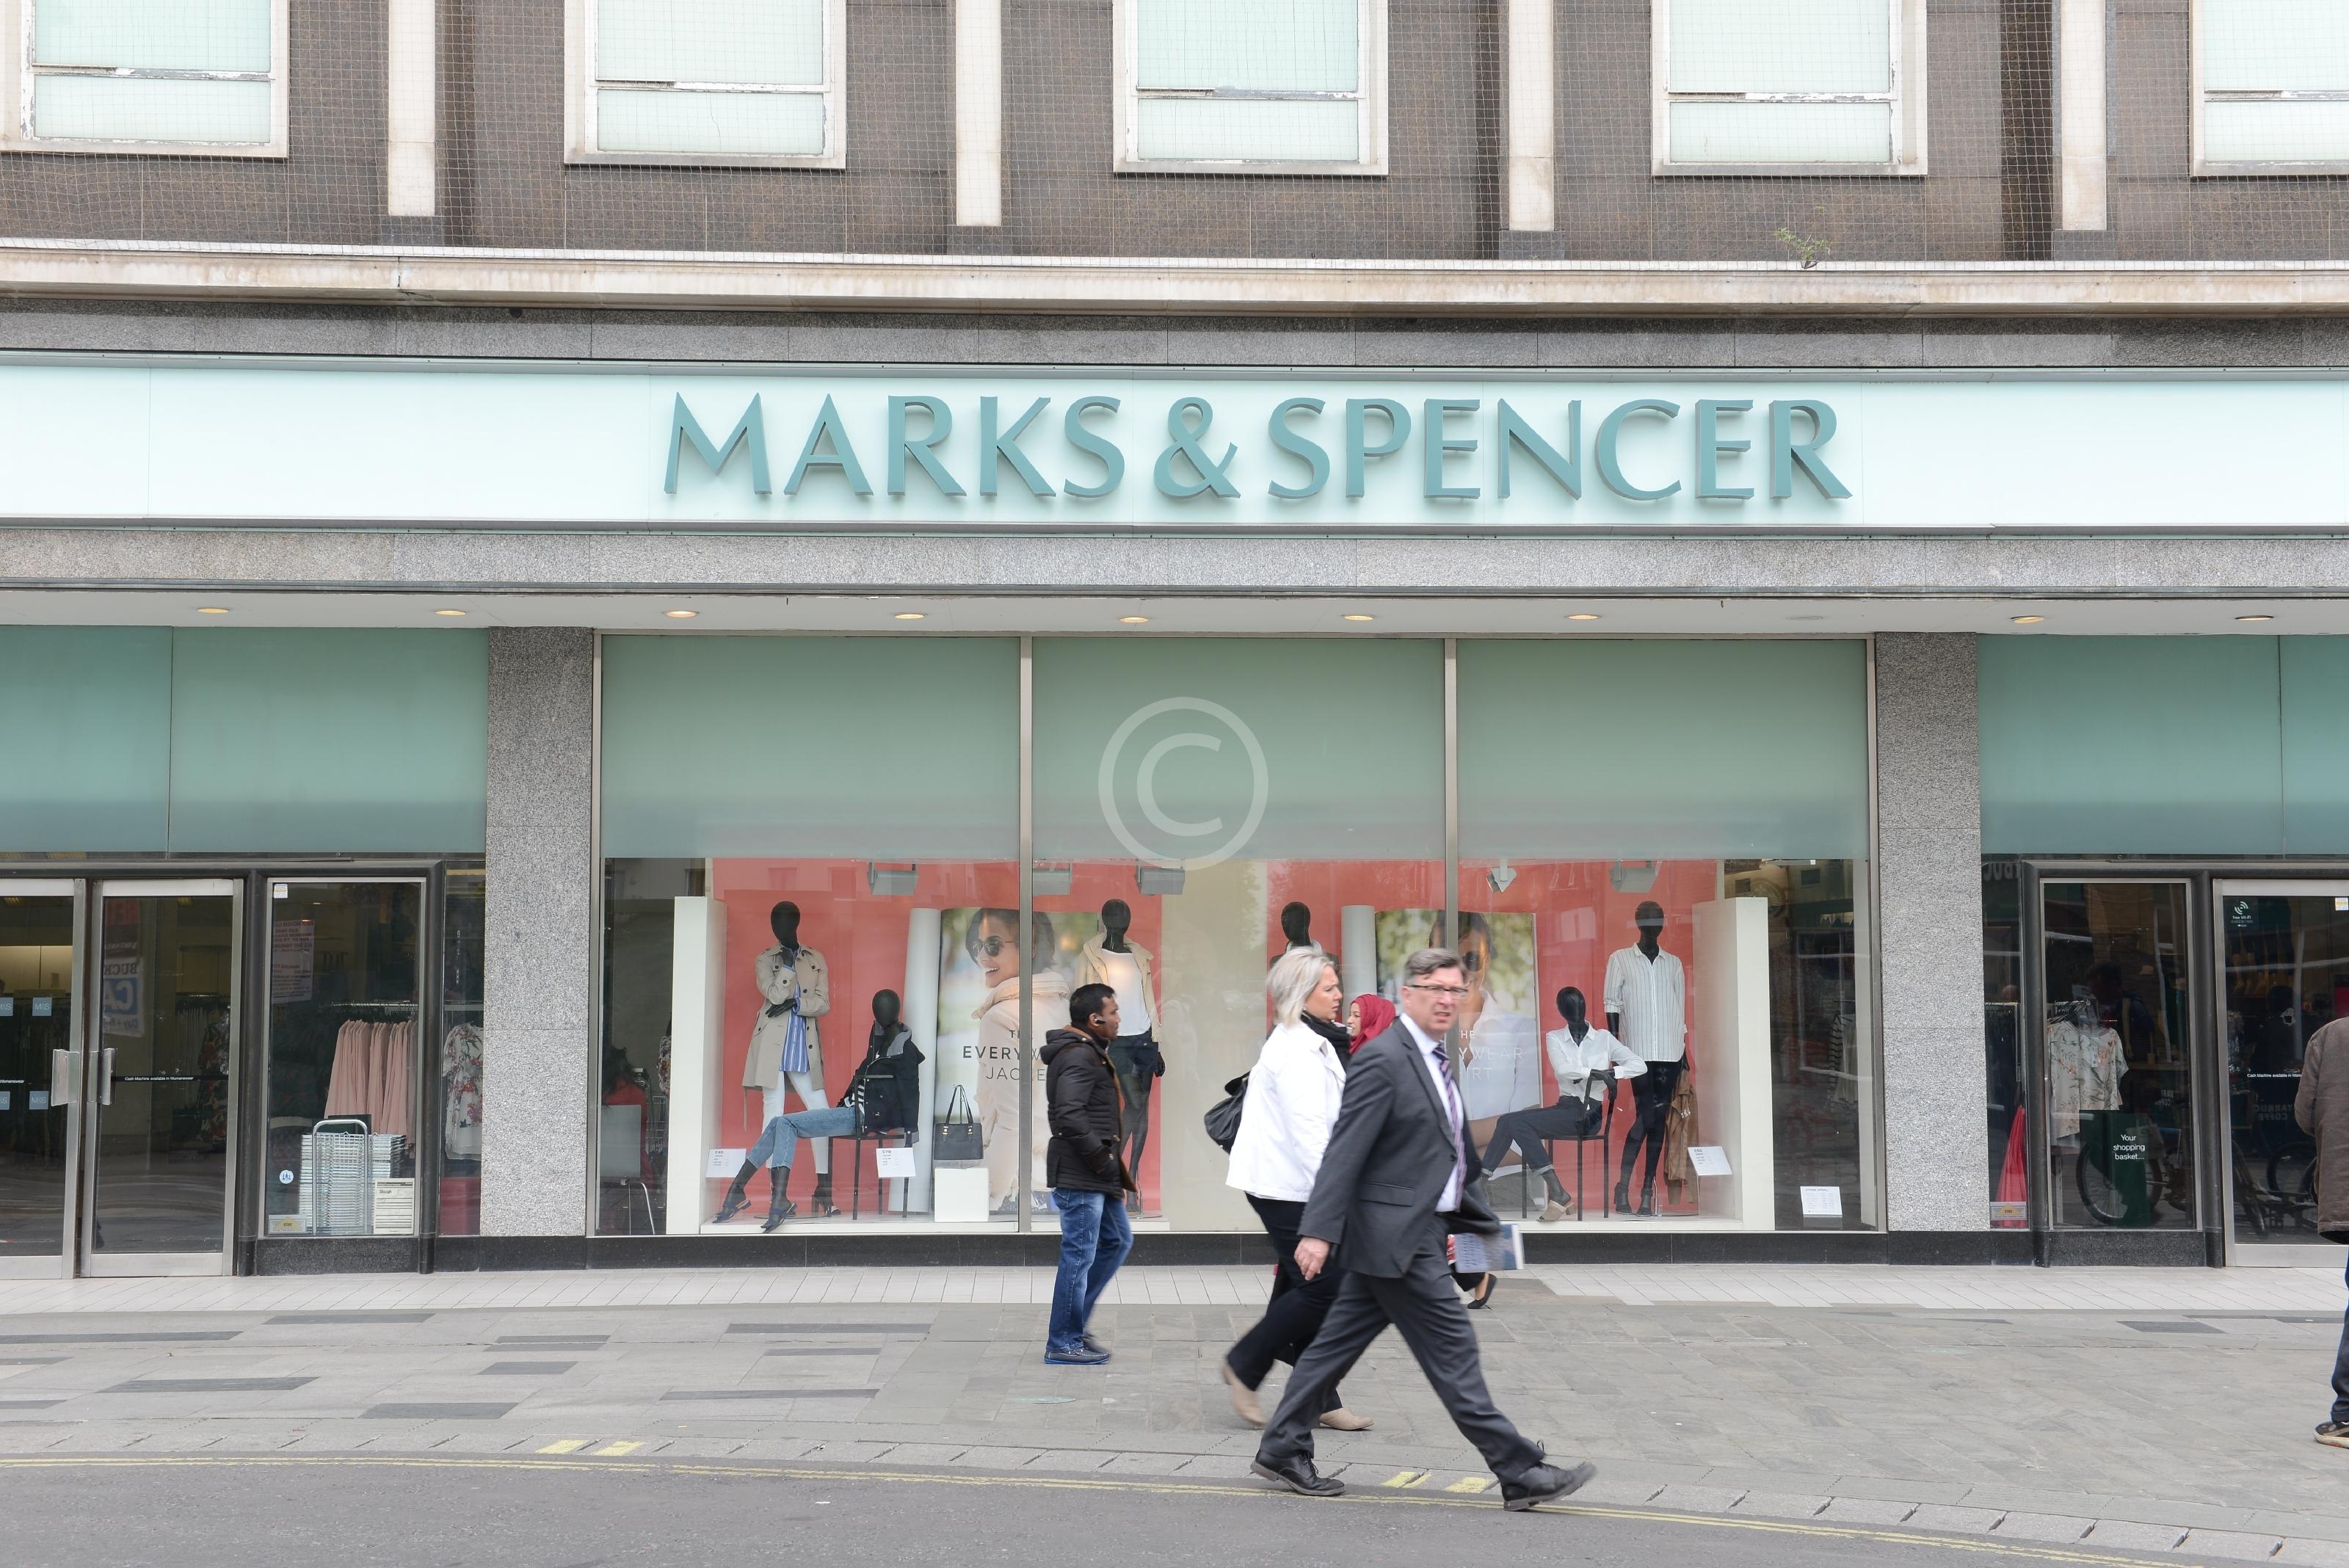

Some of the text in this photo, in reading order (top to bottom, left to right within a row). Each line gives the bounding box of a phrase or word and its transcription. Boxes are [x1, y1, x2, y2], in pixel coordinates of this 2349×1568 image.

[664, 391, 1854, 501] MARKS & SPENCER
[1461, 1030, 1475, 1039] HE
[2113, 1144, 2145, 1153] shopping
